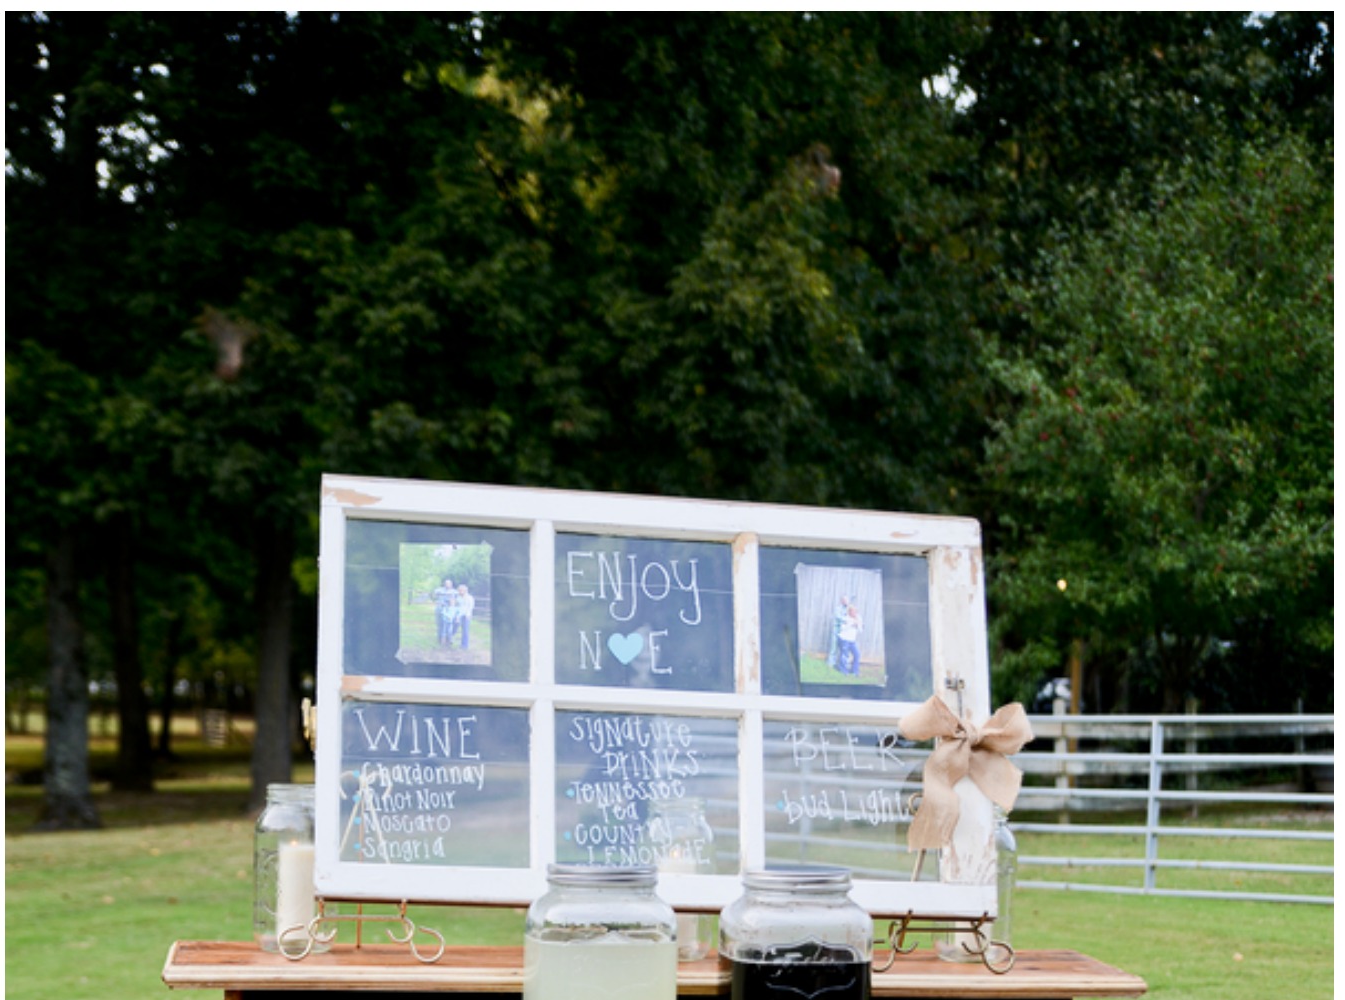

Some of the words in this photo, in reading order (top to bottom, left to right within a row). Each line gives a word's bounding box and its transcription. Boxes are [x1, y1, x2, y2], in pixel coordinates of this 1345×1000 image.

[579, 630, 602, 671] N
[649, 628, 672, 674] E
[354, 709, 481, 760] WINE
[784, 726, 905, 771] BEER
[360, 762, 484, 791] Chardonnay
[415, 788, 457, 810] Noir
[363, 813, 452, 834] Moscato
[361, 836, 446, 862] Sangria
